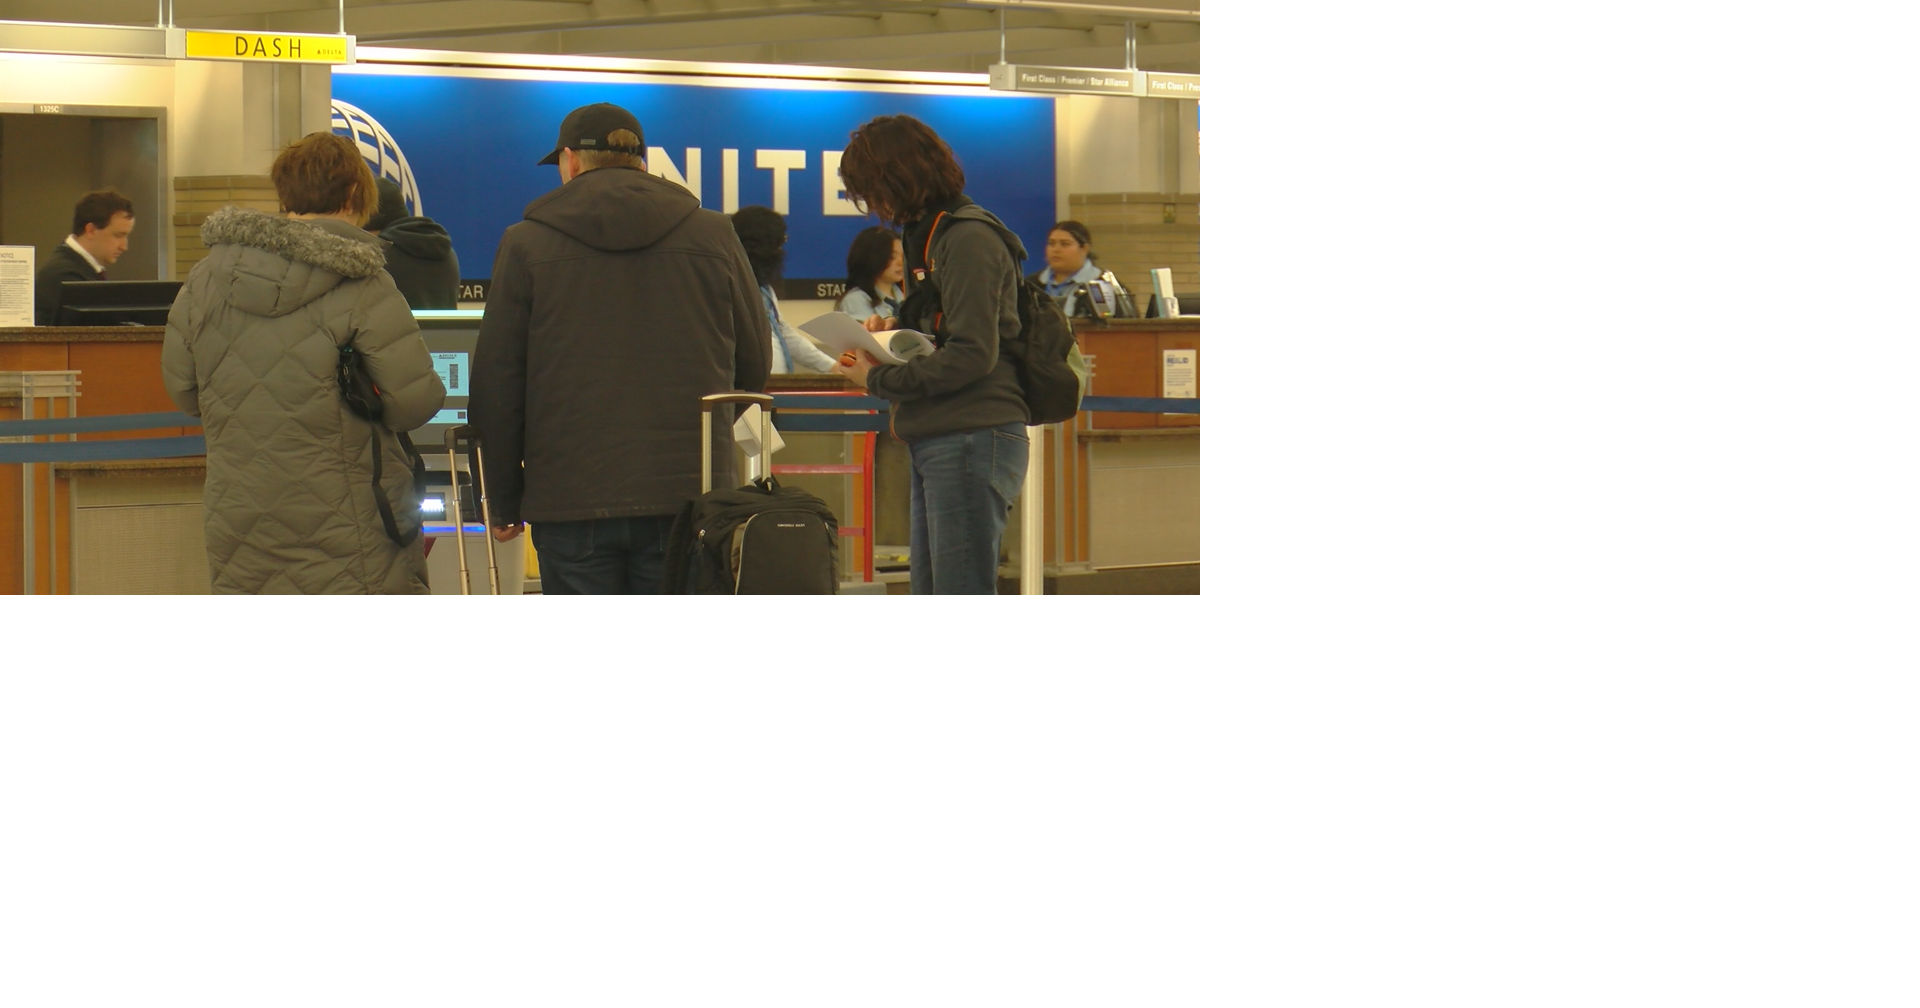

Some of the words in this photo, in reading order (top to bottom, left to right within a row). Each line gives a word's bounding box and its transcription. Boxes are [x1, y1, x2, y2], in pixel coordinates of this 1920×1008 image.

[235, 36, 301, 58] DASH
[1022, 73, 1037, 82] First
[1038, 74, 1056, 83] Class
[1061, 75, 1086, 85] Premier
[1090, 76, 1104, 86] Star
[1104, 77, 1130, 87] Alliance
[1152, 80, 1167, 89] First
[1167, 81, 1184, 90] Class
[40, 105, 60, 113] 1325C
[647, 147, 869, 216] NITE
[458, 284, 484, 298] AR
